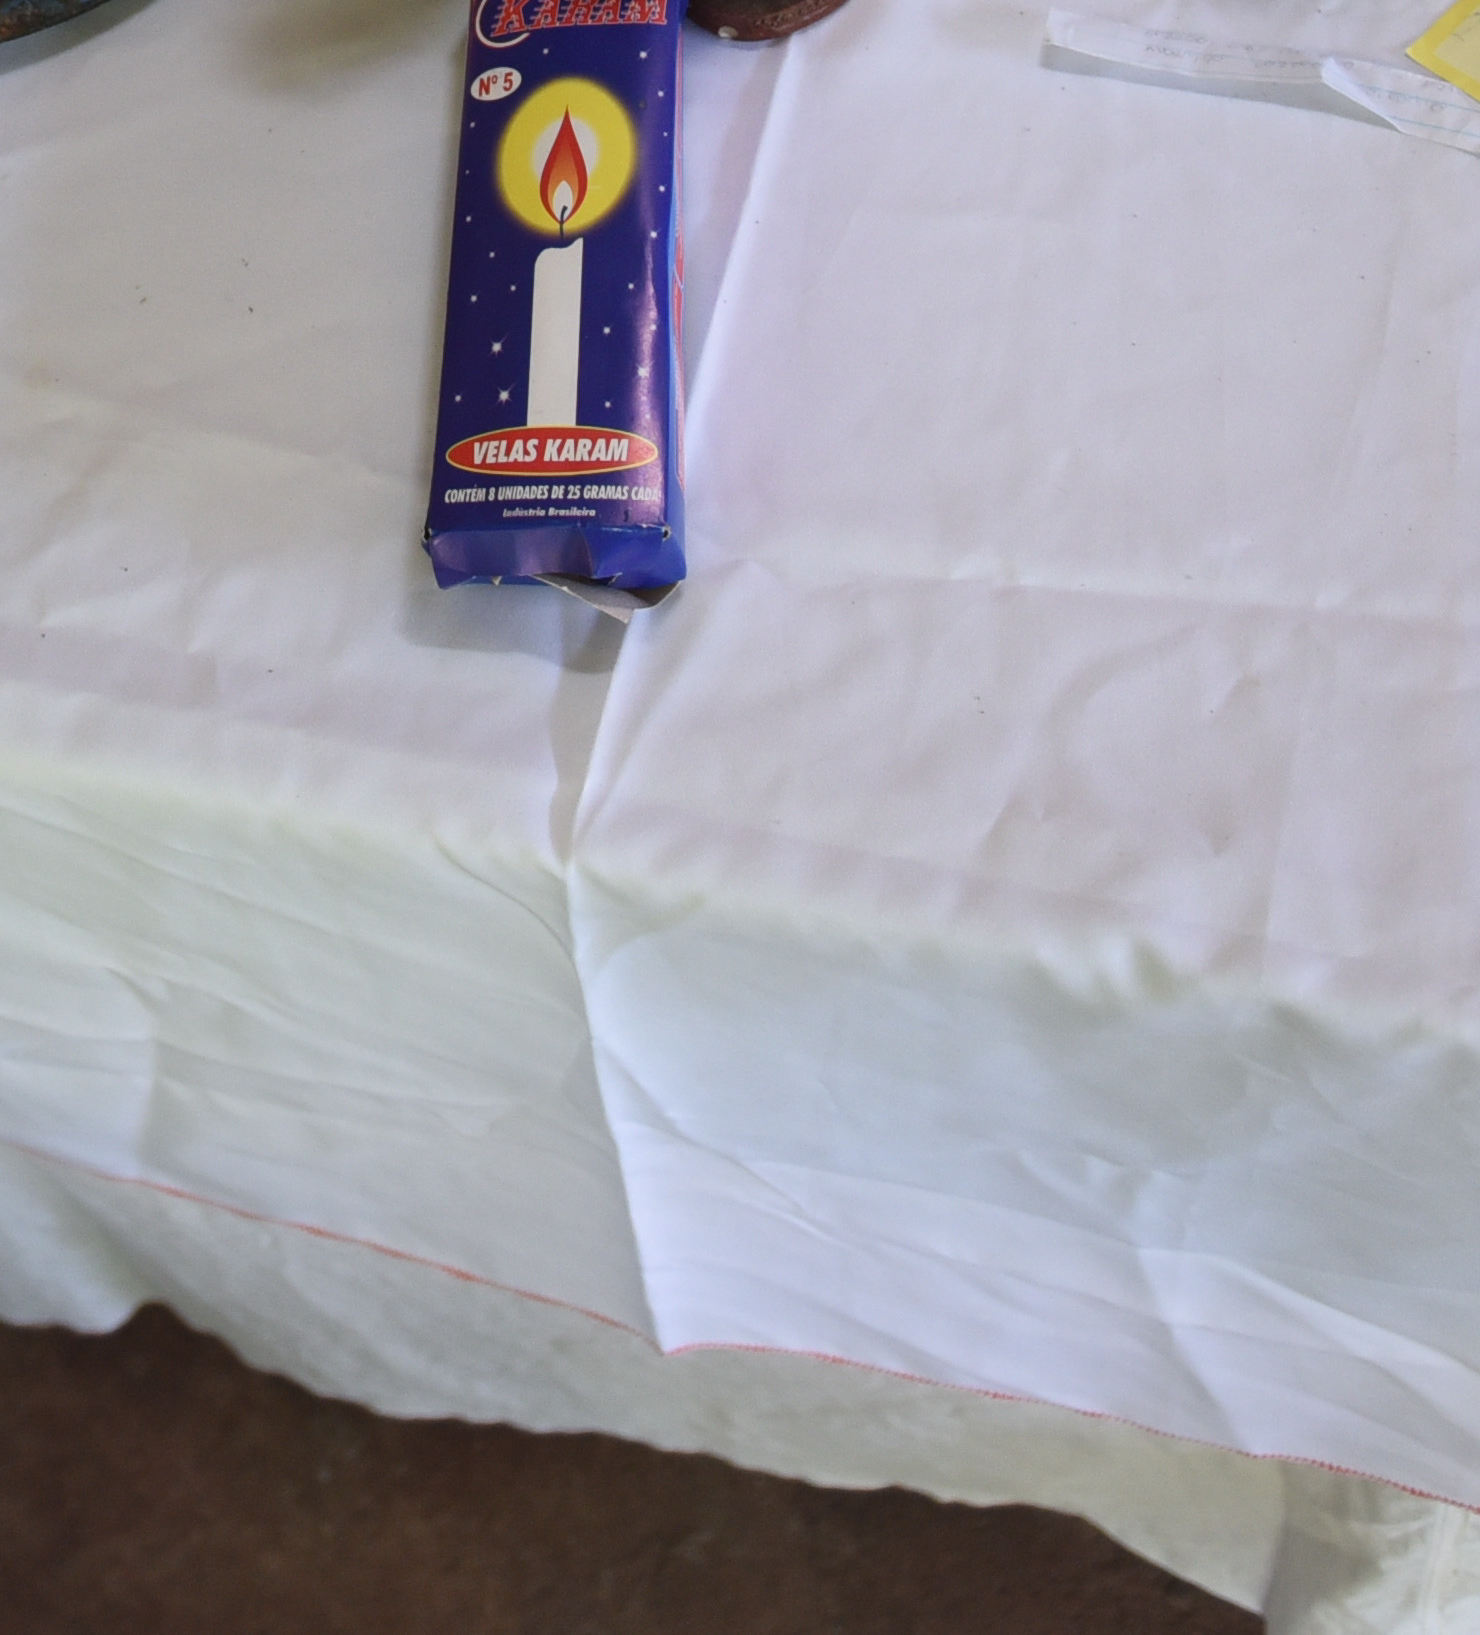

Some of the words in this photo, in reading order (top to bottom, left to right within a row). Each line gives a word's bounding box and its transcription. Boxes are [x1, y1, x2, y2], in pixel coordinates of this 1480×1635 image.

[503, 71, 514, 93] 5
[472, 438, 539, 465] VELAS
[543, 438, 629, 463] KARAM
[488, 486, 496, 502] 8
[497, 485, 550, 502] UNIDADES
[551, 484, 566, 500] DE
[567, 484, 582, 500] 25
[583, 485, 630, 501] GRAMAS
